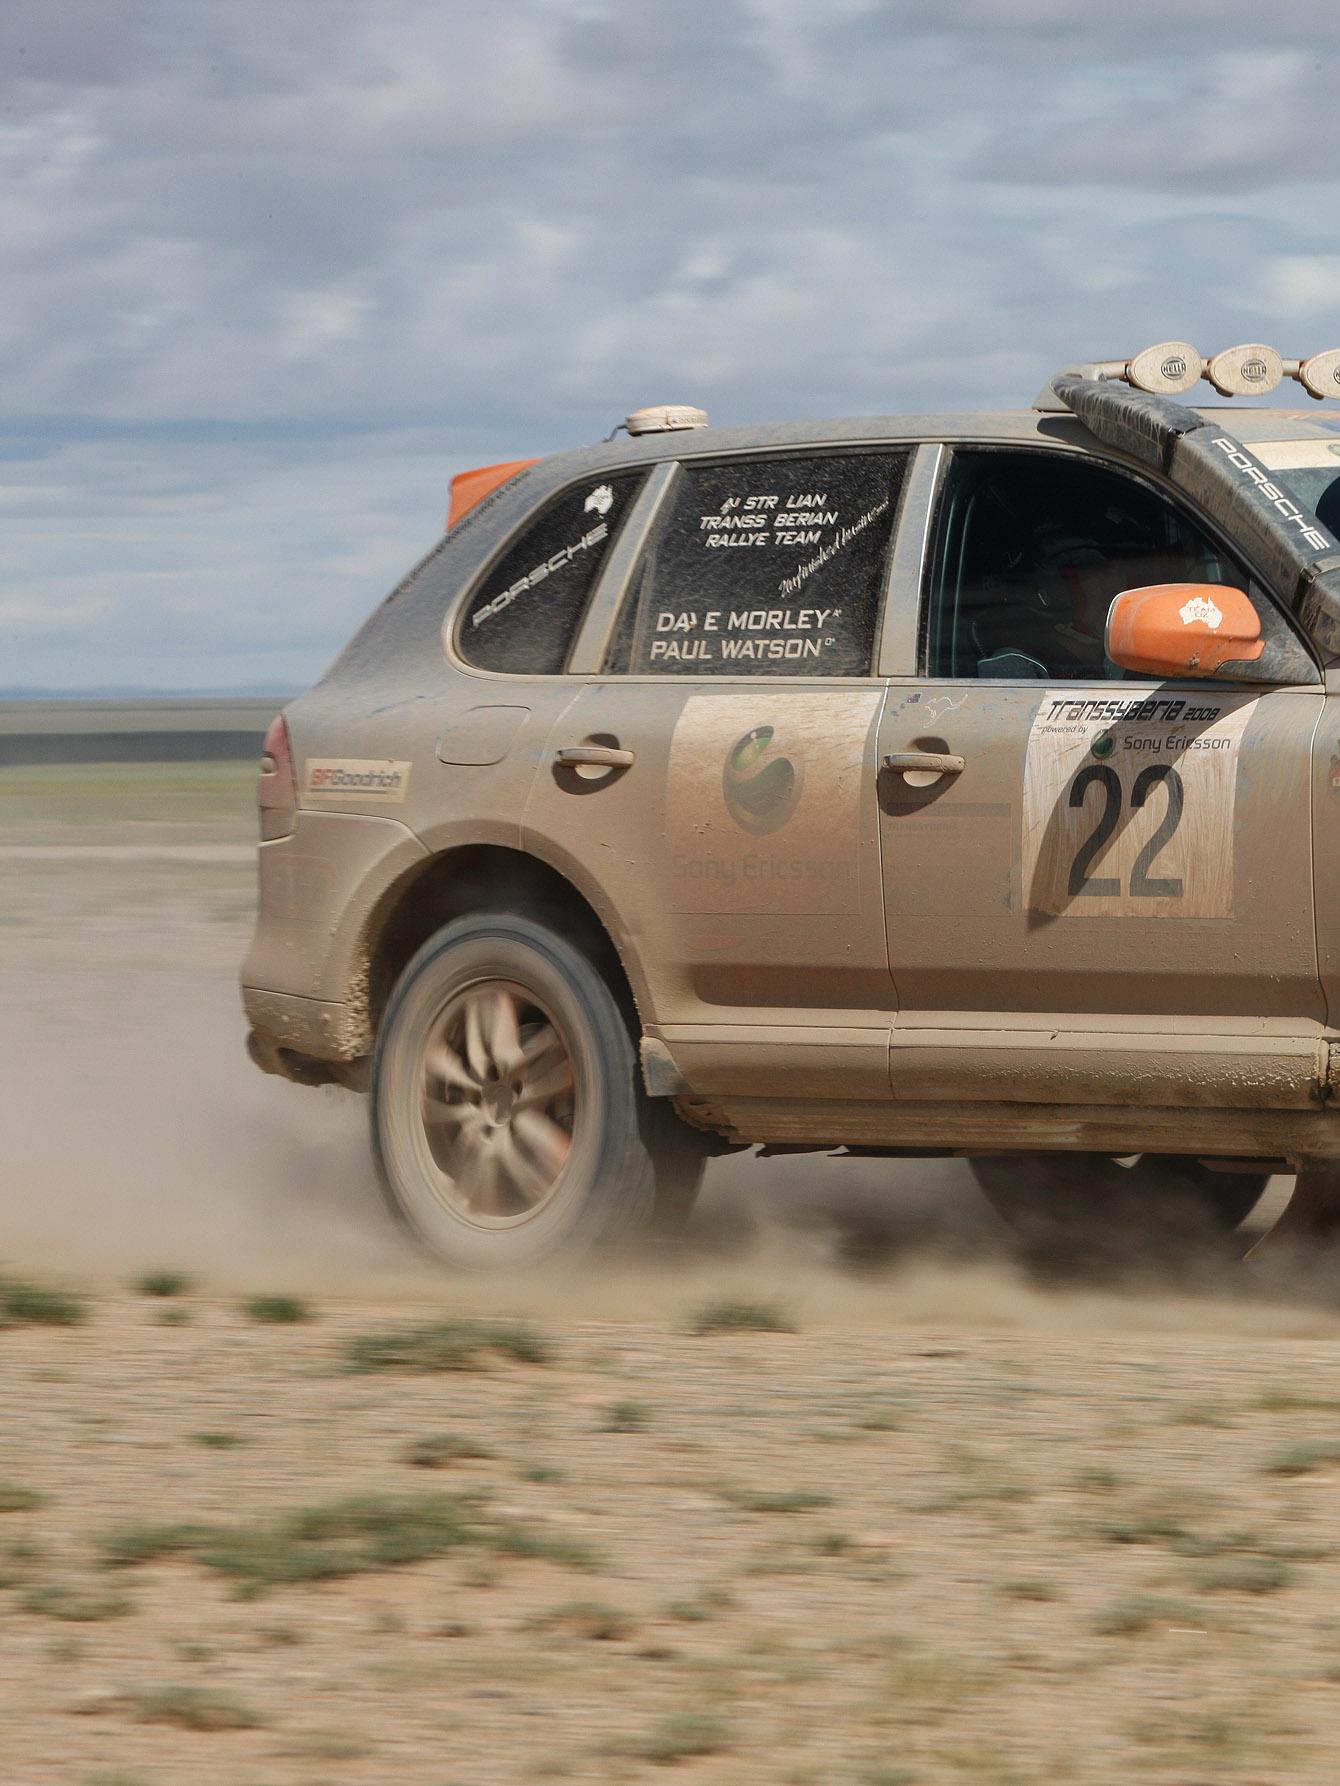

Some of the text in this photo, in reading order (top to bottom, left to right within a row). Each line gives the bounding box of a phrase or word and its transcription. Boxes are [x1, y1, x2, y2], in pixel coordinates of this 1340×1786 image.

[1211, 438, 1331, 551] PORSCHE
[705, 530, 822, 547] RALLYE TEAM
[472, 522, 609, 627] PORSCHE
[727, 609, 831, 630] MORLEY
[650, 640, 712, 660] PAUL
[721, 638, 822, 659] WATSON
[1182, 707, 1221, 721] 2008
[1042, 726, 1088, 735] powered by
[1123, 736, 1231, 753] Sony Ericsson
[311, 768, 401, 788] BFGoodrich
[1068, 764, 1184, 897] 22
